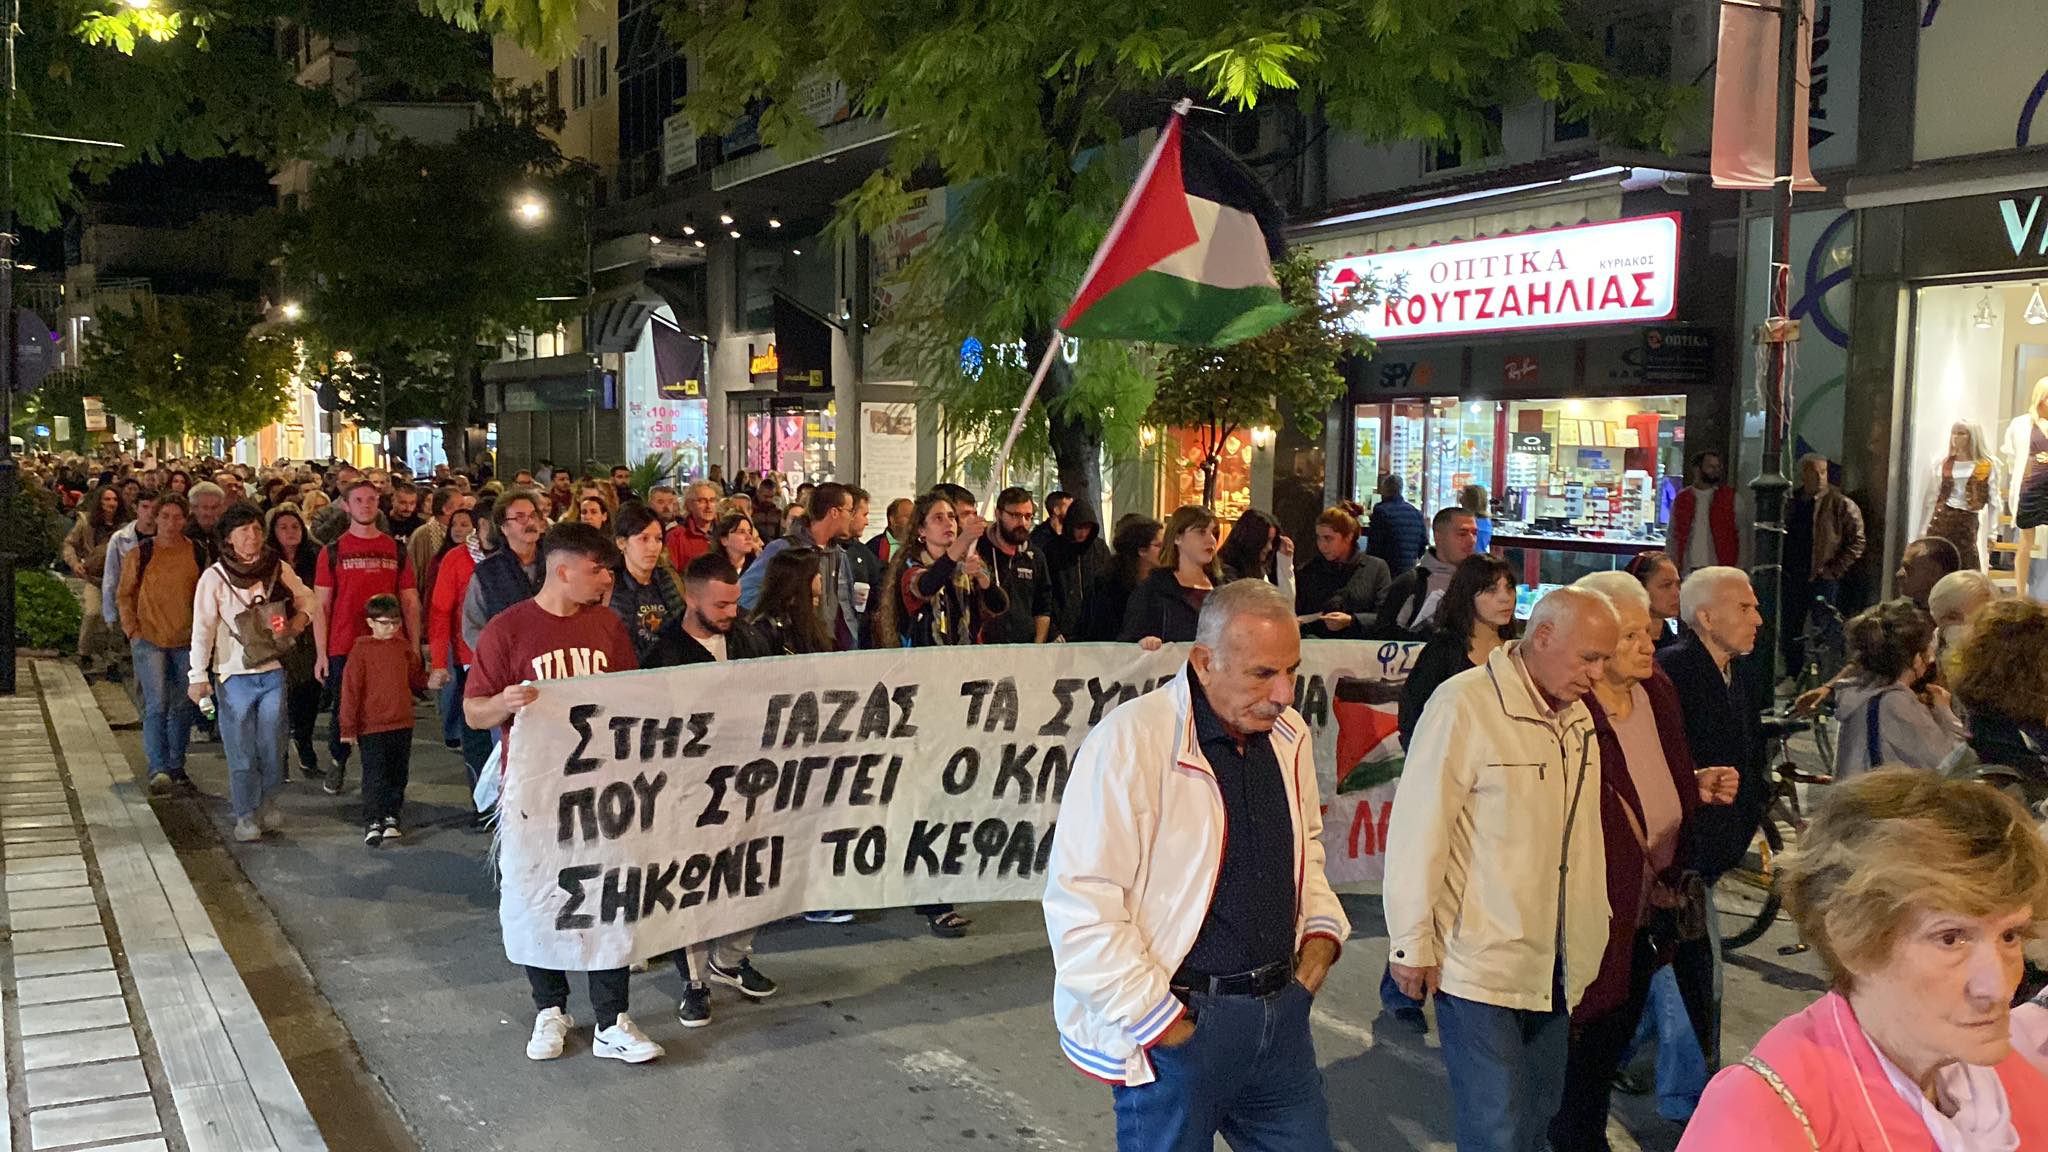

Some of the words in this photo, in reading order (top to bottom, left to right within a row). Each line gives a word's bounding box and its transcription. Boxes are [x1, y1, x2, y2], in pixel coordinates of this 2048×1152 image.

[1999, 195, 2048, 256] V
[1430, 249, 1568, 284] ΟΠΤΙΚΑ
[1600, 255, 1654, 270] ΚΥΡΙΑΚΟΣ
[1385, 271, 1655, 326] ΚΟΥΤΖΑΗΛΙΑΣ
[564, 703, 715, 776] ΣΤΗΣ
[761, 681, 920, 749] ΓΑΖΑΣ
[960, 676, 1019, 732] ΤΑ
[558, 771, 668, 848] ΠΟΥ
[696, 754, 903, 828] ΣΦΙΓΓΕΙ
[942, 746, 981, 795] Ο
[992, 743, 1082, 804] ΚΛ
[555, 836, 784, 930] ΣΗΚΩΝΕΙ
[821, 825, 887, 876] ΤΟ
